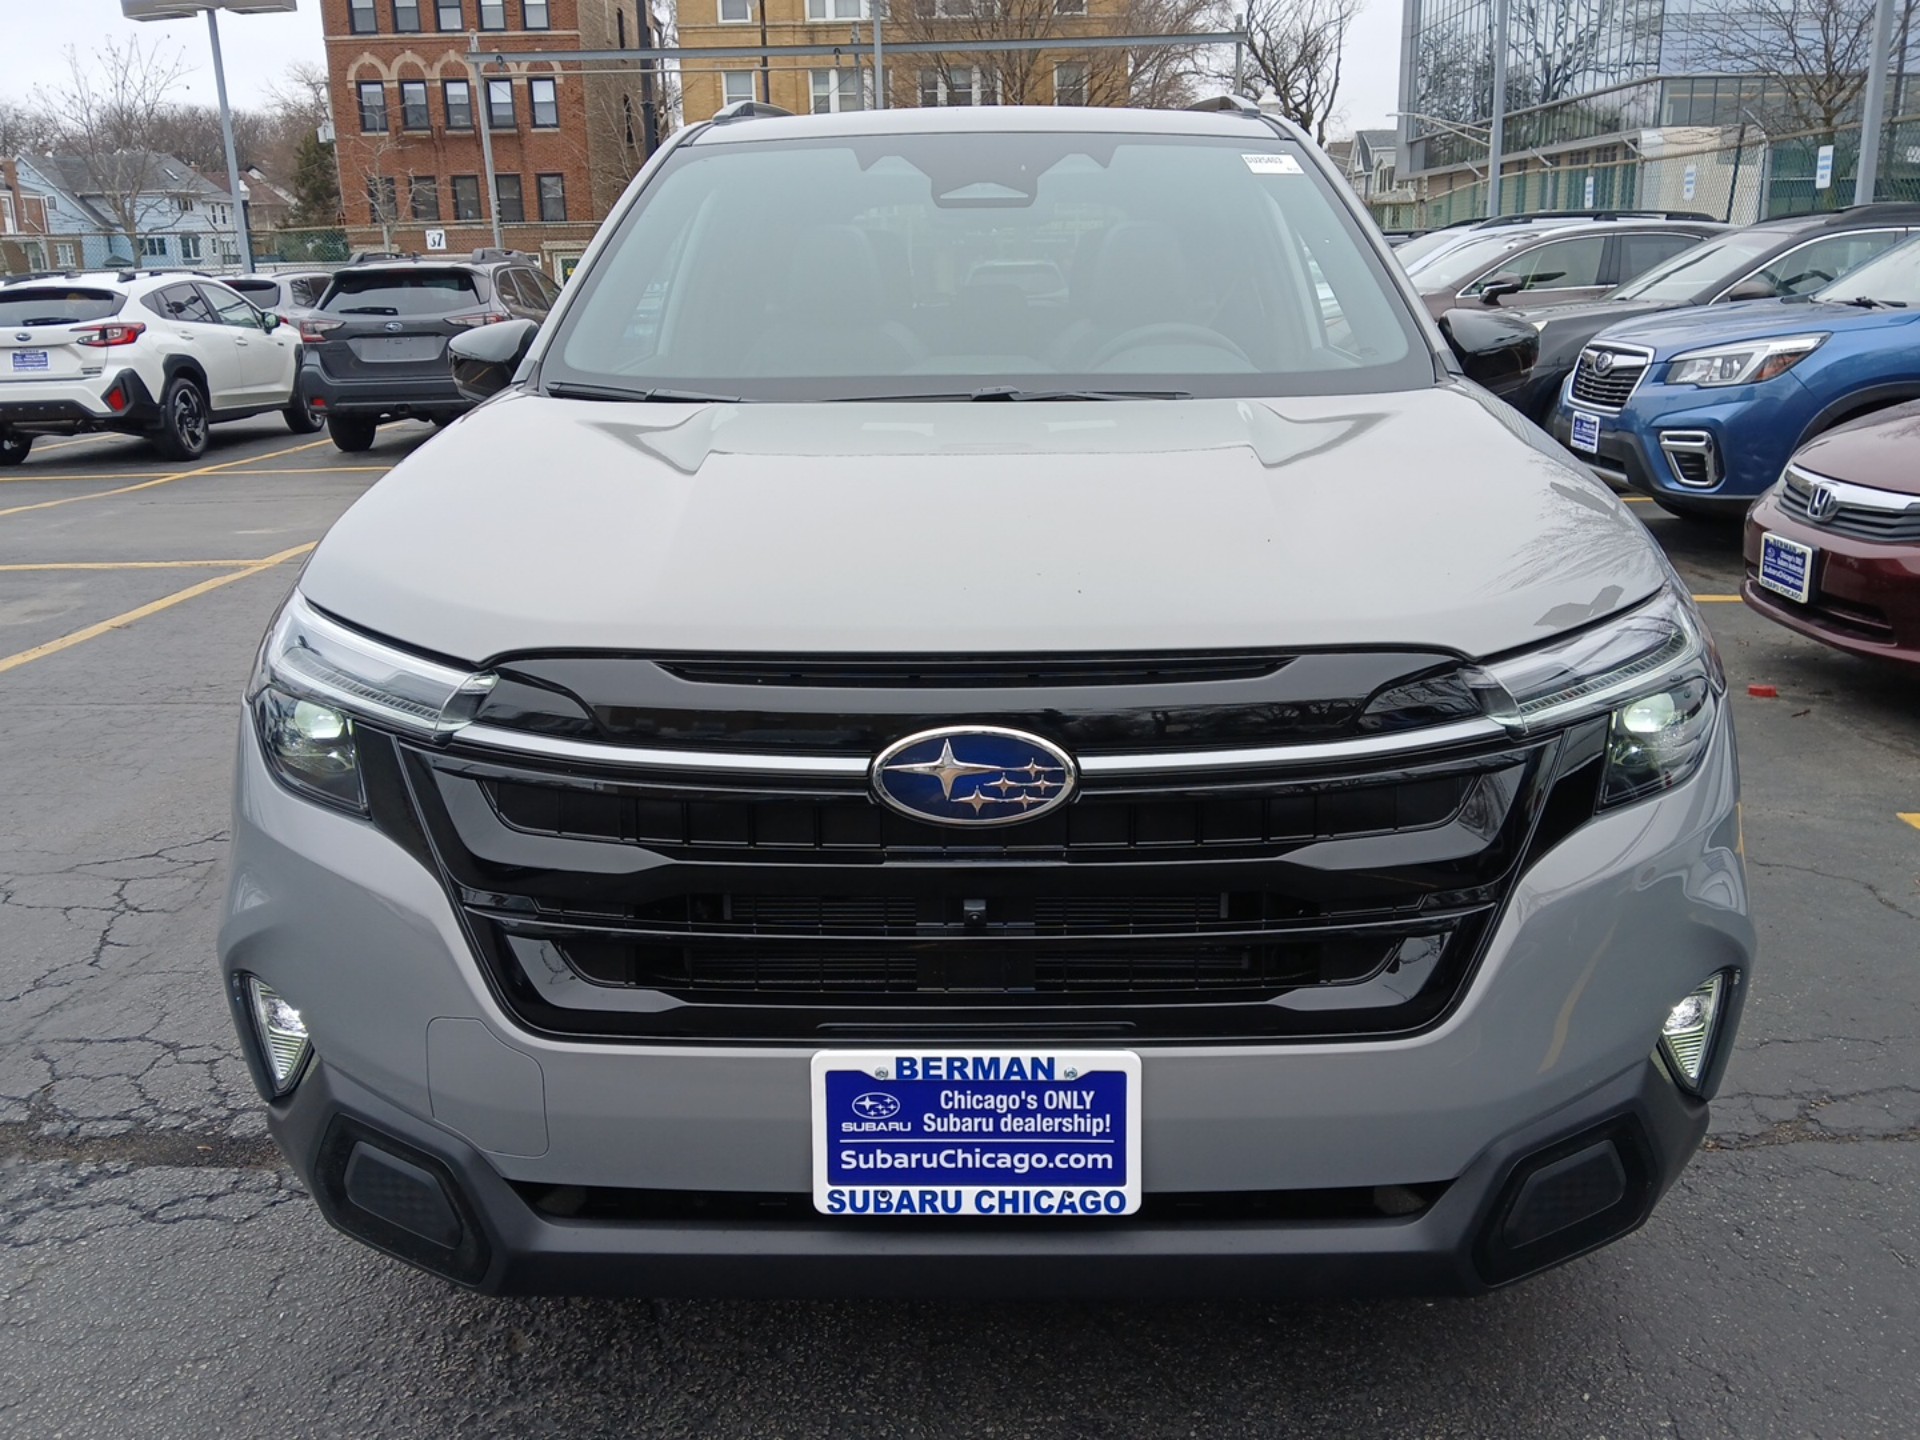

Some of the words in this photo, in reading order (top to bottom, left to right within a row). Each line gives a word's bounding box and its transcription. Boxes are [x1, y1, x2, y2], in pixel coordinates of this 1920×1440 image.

[895, 1057, 1055, 1080] BERMAN
[940, 1090, 1038, 1113] Chicago's
[1044, 1090, 1095, 1110] ONLY
[841, 1121, 912, 1132] SUBARU
[923, 1113, 994, 1133] Subaru
[1000, 1113, 1111, 1136] dealership!
[841, 1148, 1113, 1174] SubaruChicago.com
[826, 1190, 963, 1214] SUBARU
[974, 1190, 1127, 1214] CHICAGO
